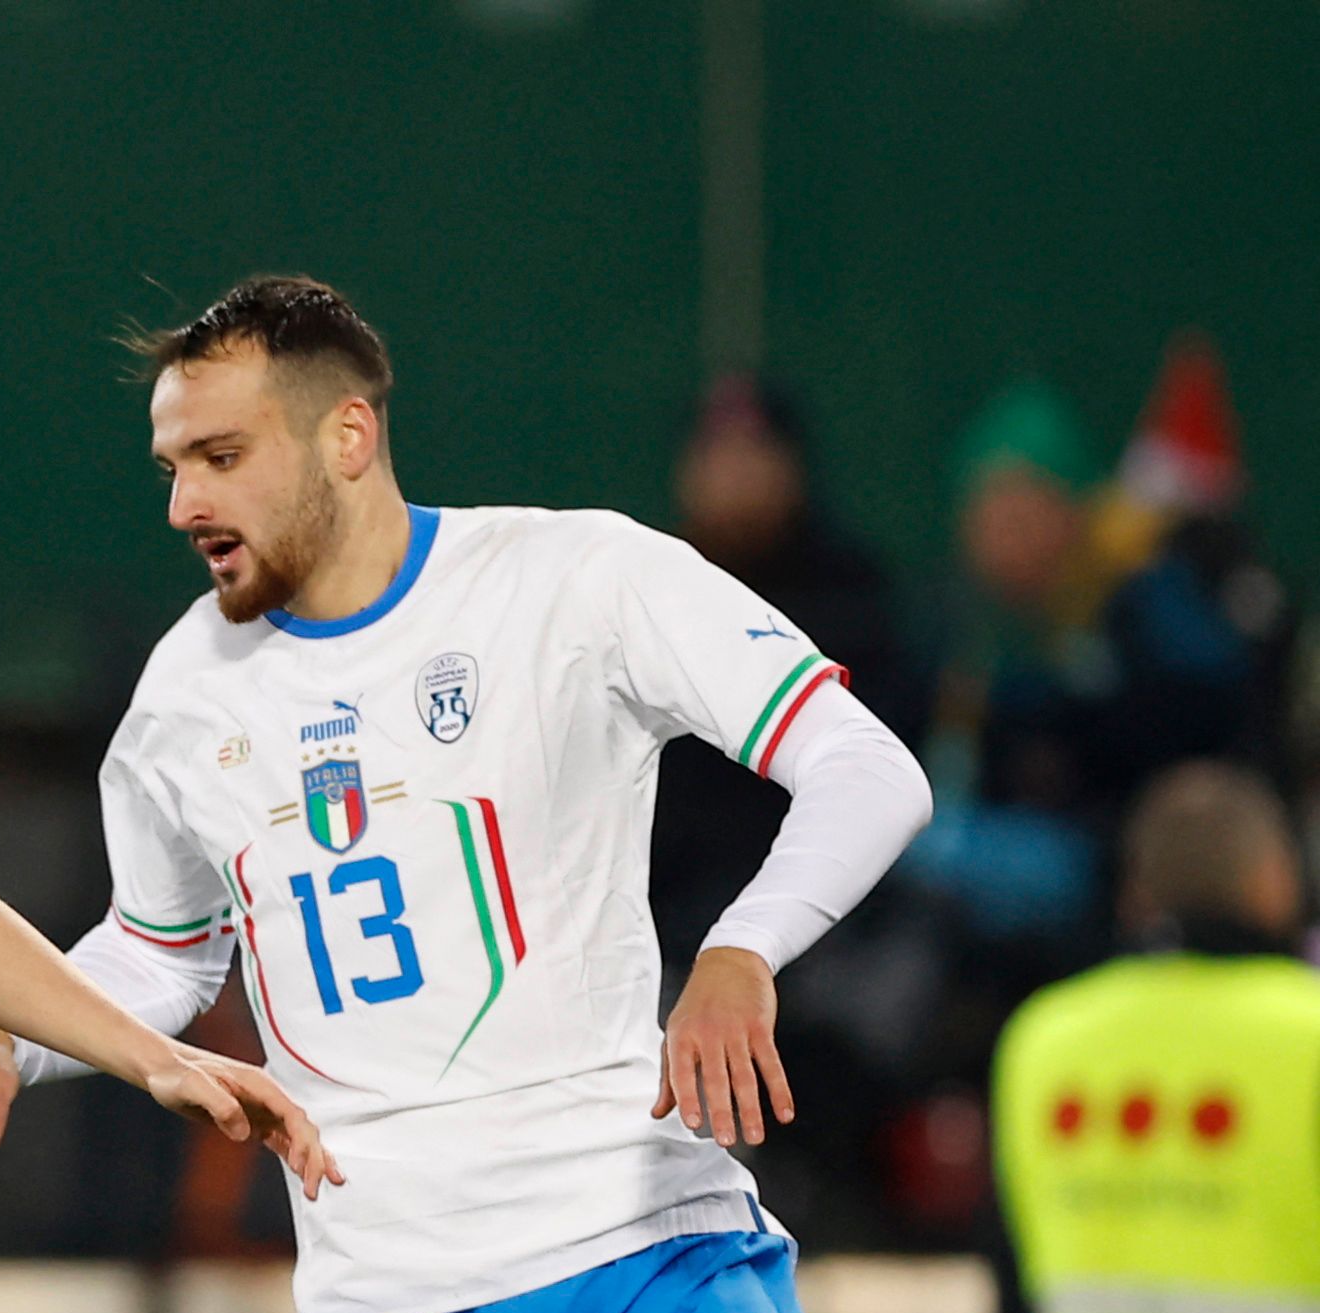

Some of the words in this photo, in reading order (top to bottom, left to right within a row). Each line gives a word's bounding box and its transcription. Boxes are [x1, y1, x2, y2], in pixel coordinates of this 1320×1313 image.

[300, 716, 357, 744] PUMA
[307, 766, 357, 787] ITALIA
[288, 855, 425, 1016] 13
